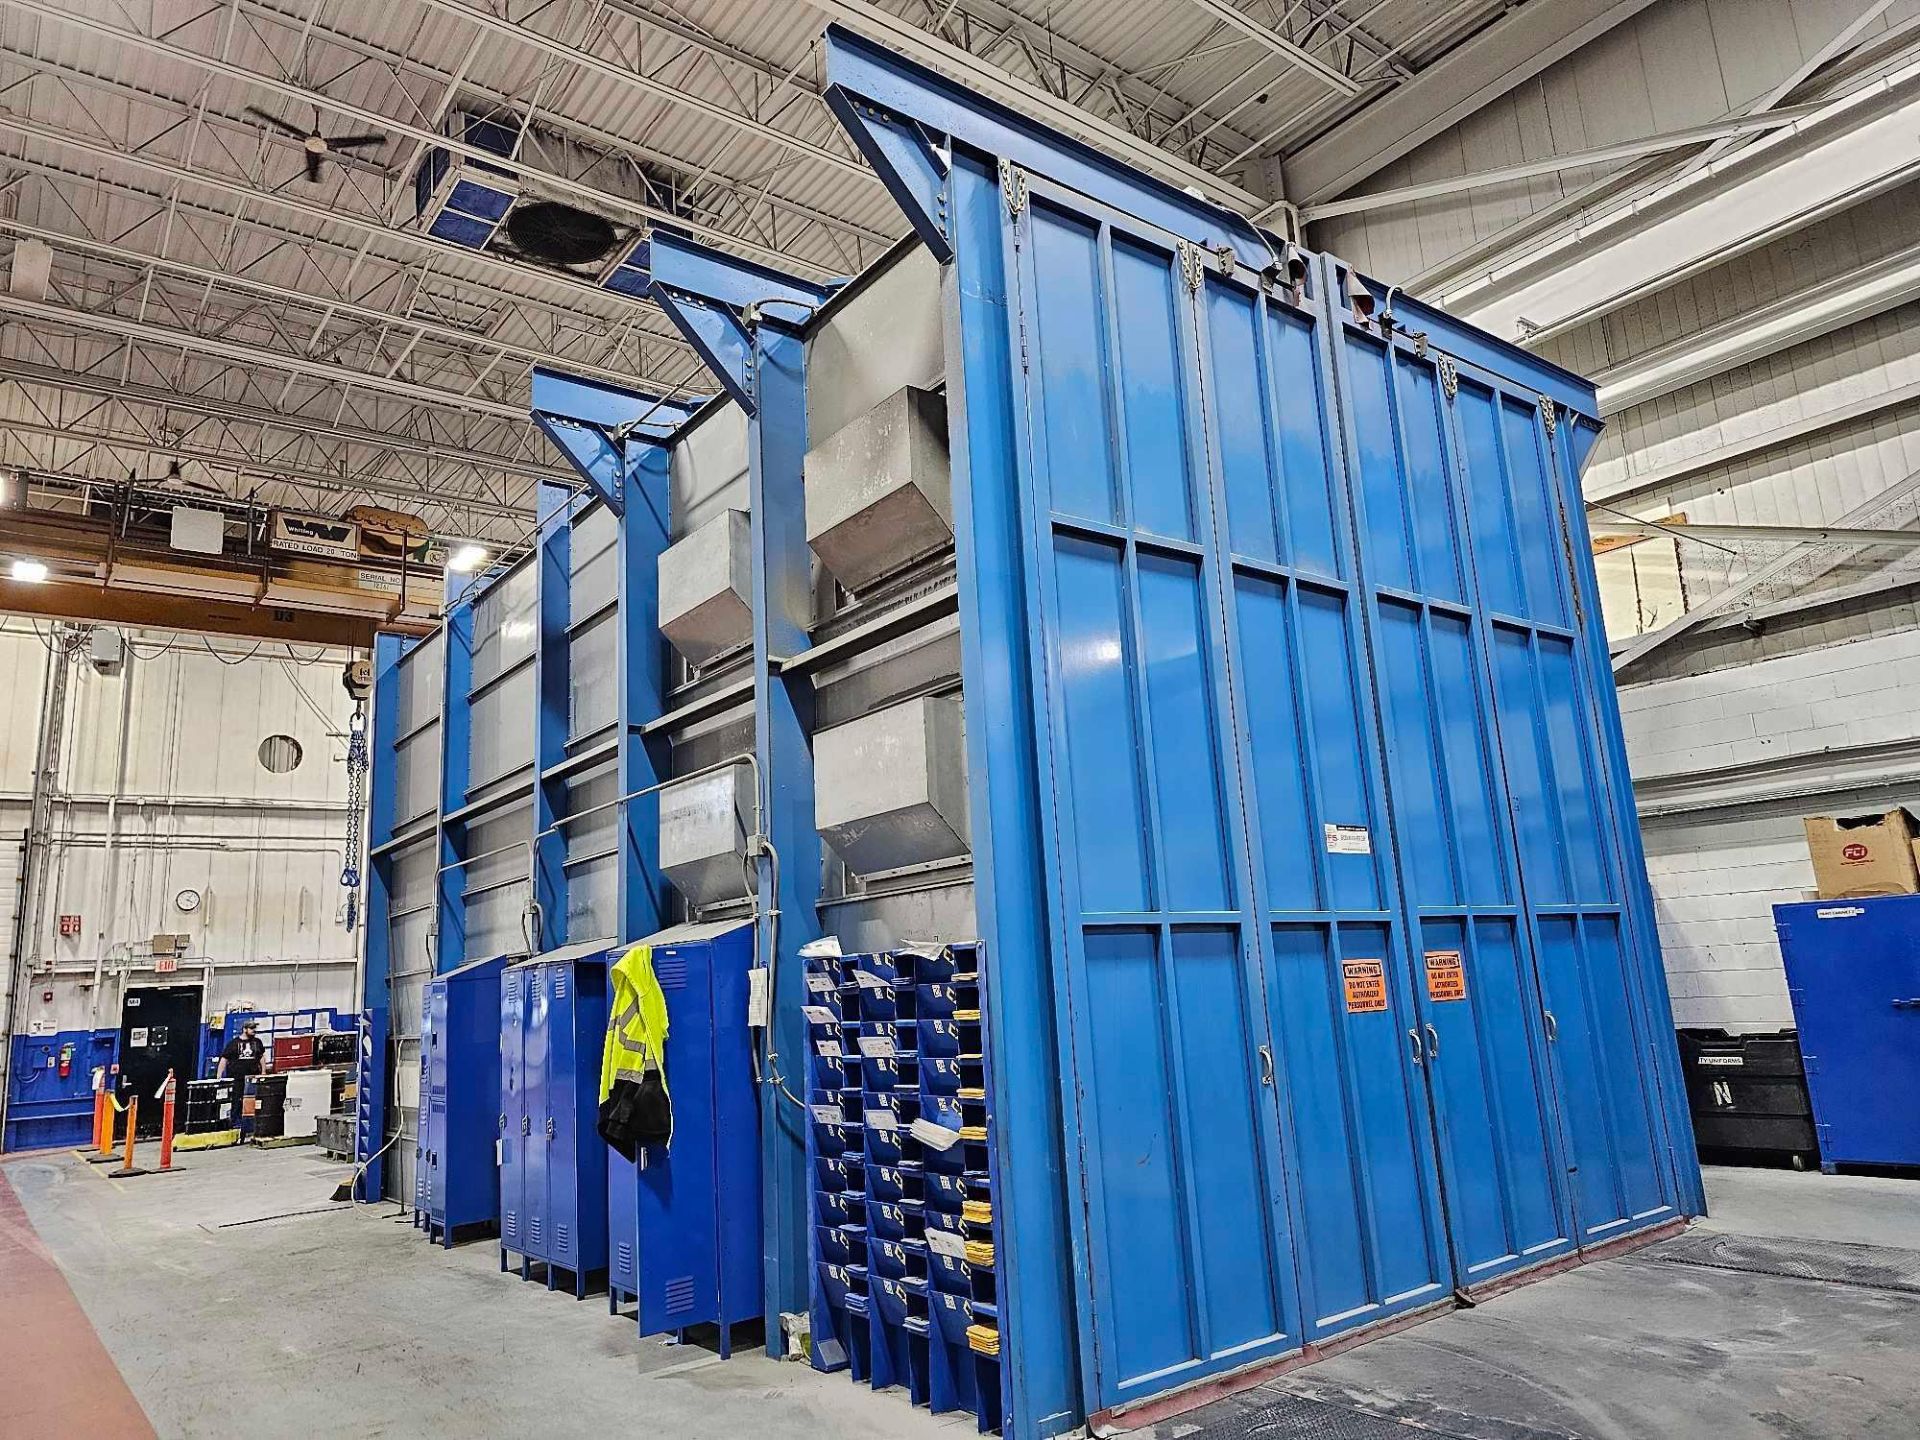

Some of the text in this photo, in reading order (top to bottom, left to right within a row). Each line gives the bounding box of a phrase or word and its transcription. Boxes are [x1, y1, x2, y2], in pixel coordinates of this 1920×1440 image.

[288, 526, 314, 536] Whiting
[273, 539, 299, 550] RATED
[302, 542, 324, 554] LOAD
[360, 572, 386, 582] SERIAL
[1429, 957, 1457, 967] WARNING
[1347, 965, 1378, 975] WARNING
[1356, 980, 1366, 989] NOT
[1365, 979, 1380, 989] ENTER
[1348, 1000, 1374, 1009] PERSONNEL
